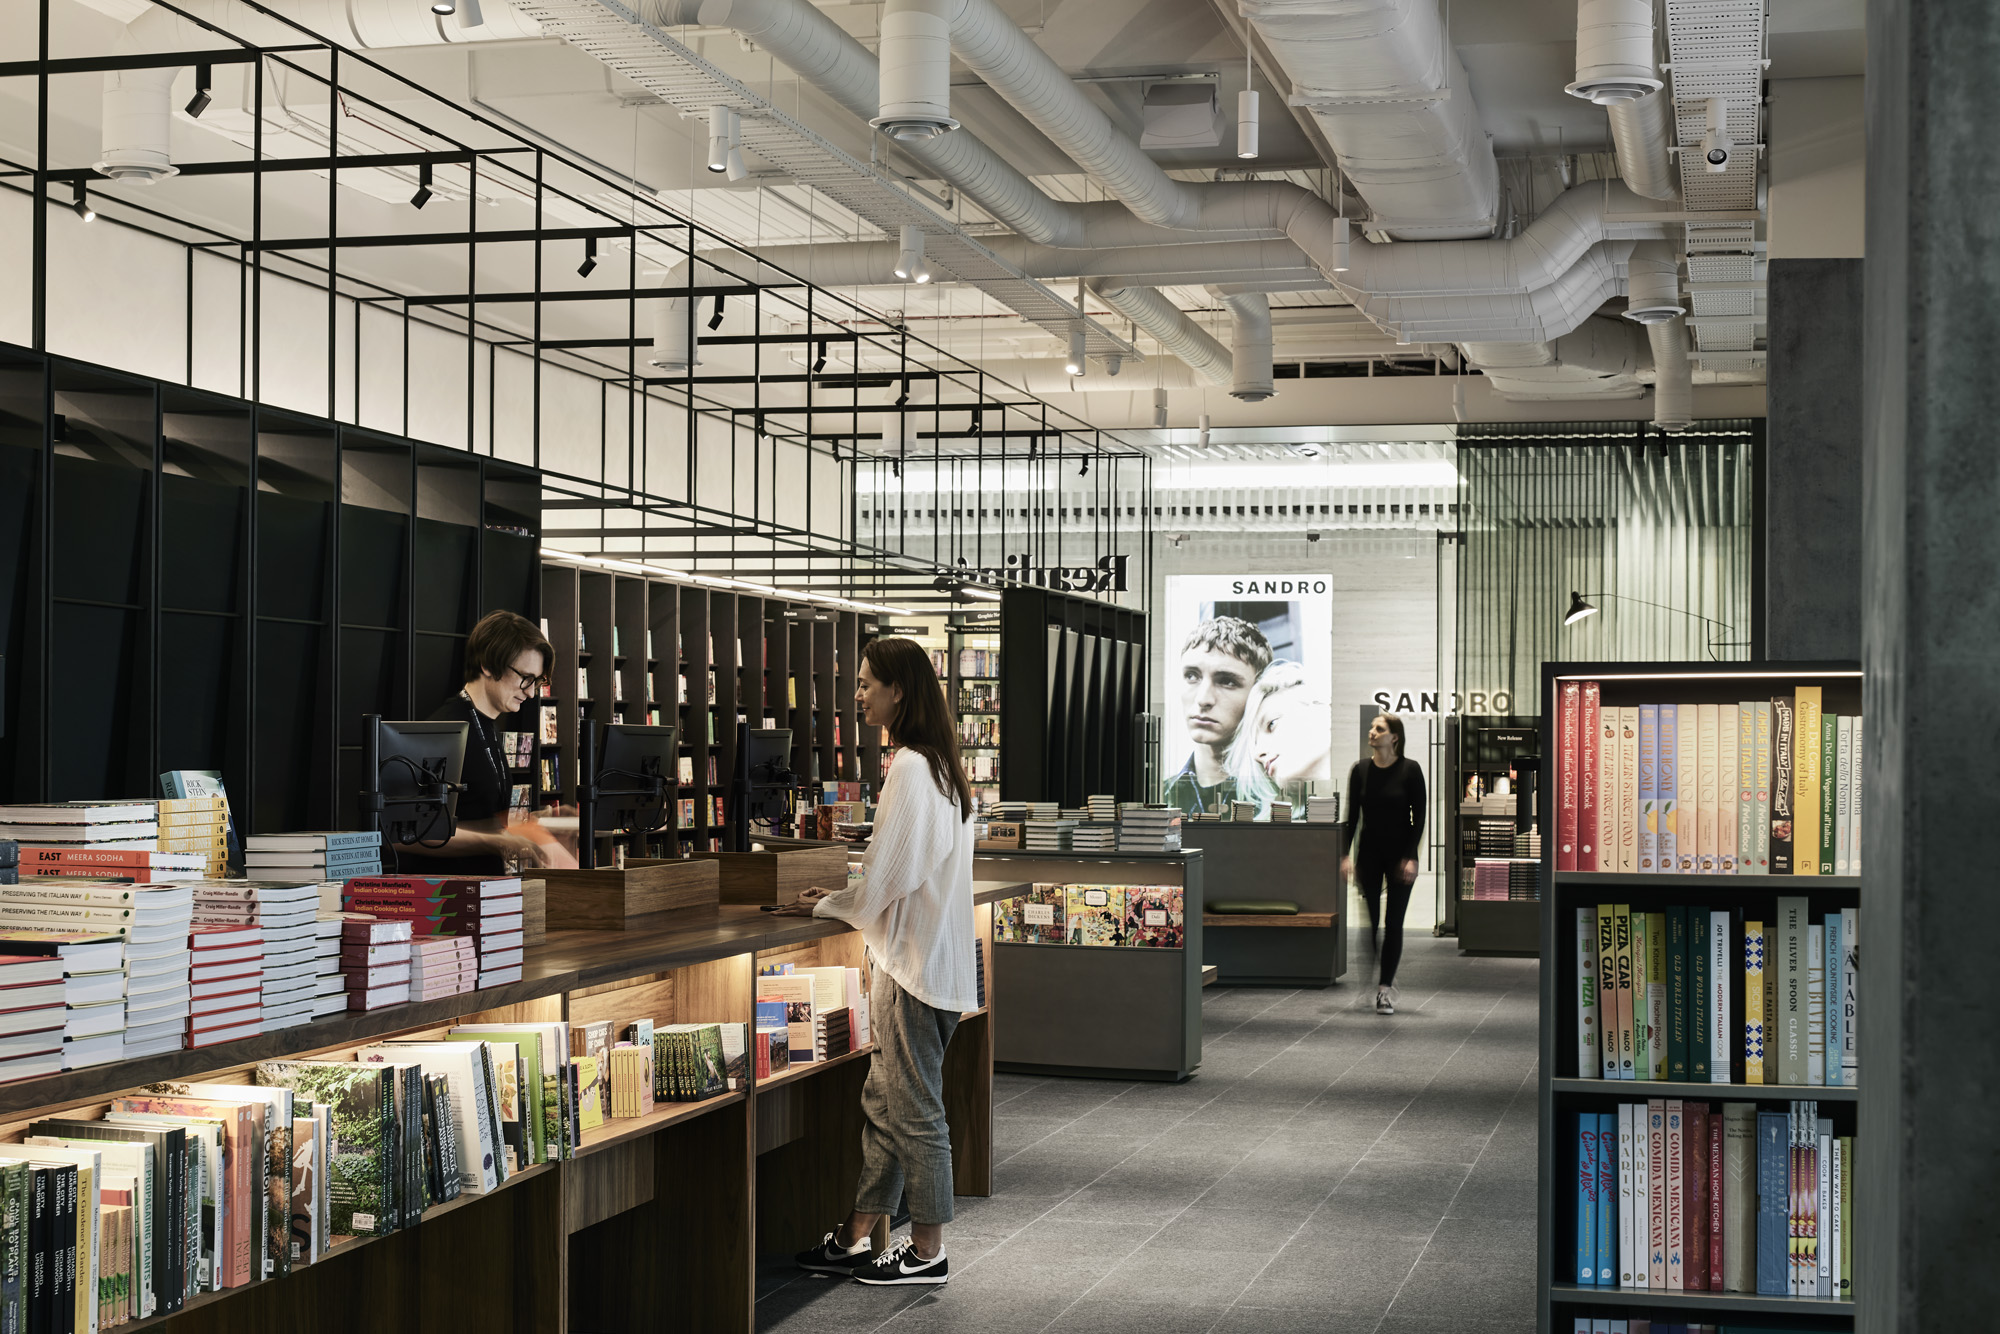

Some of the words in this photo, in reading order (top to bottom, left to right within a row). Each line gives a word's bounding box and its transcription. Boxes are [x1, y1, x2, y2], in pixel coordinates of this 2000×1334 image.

[1232, 581, 1326, 595] SANDRO
[1374, 692, 1512, 713] SANDRO
[1809, 701, 1818, 728] Anna
[1641, 724, 1654, 755] BITTER
[1741, 709, 1752, 745] SIMPLE
[1796, 701, 1808, 761] Gastronomy
[1809, 731, 1818, 749] Del
[1839, 728, 1849, 754] Torta
[1641, 758, 1654, 792] HONEY
[1741, 748, 1752, 788] ITALIAN
[1808, 752, 1818, 782] Conte
[1824, 757, 1832, 776] Conte
[1839, 757, 1849, 781] della
[185, 779, 202, 788] RICK
[188, 789, 207, 797] STEIN
[1797, 776, 1808, 798] Italy
[1823, 777, 1832, 812] Vegetables
[1741, 803, 1752, 823] Silvia
[1839, 784, 1849, 815] Nonna
[331, 837, 342, 846] RICK
[342, 837, 354, 845] STEIN
[355, 836, 360, 844] AT
[361, 835, 373, 843] HOME
[1741, 825, 1752, 852] Colloca
[39, 852, 62, 861] EAST
[95, 854, 124, 862] SODHA
[2, 890, 36, 898] PRESERVING
[1600, 917, 1612, 952] PIZZA
[1617, 915, 1628, 951] PIZZA
[1789, 909, 1797, 930] THE
[1789, 936, 1797, 972] SILVER
[1602, 956, 1613, 989] CZAR
[1618, 956, 1630, 989] CZAR
[1582, 976, 1594, 1007] PIZZA
[1674, 974, 1682, 1004] WORLD
[1751, 986, 1761, 1012] SICILY
[1789, 979, 1797, 1012] SPOON
[587, 1029, 598, 1040] SHOP
[598, 1027, 607, 1037] CATS
[1653, 1026, 1661, 1049] Roddy
[1674, 1006, 1682, 1042] ITALIAN
[1696, 1007, 1704, 1044] ITALIAN
[1789, 1018, 1797, 1061] CLASSIC
[481, 1046, 494, 1117] BIRDSCAPING
[264, 1105, 272, 1137] Piet
[475, 1086, 484, 1143] FLOWERS
[446, 1125, 455, 1174] AUSTRALIA
[1652, 1132, 1662, 1181] COMIDA
[1670, 1133, 1680, 1181] COMIDA
[263, 1139, 271, 1197] Oudolf
[1621, 1134, 1630, 1198] PARIS
[144, 1170, 152, 1240] PROPAGATING
[1652, 1184, 1662, 1248] MEXICANA
[1670, 1184, 1680, 1248] MEXICANA
[1834, 1202, 1839, 1211] TO
[8, 1230, 15, 1243] TO
[235, 1242, 243, 1275] PETAL
